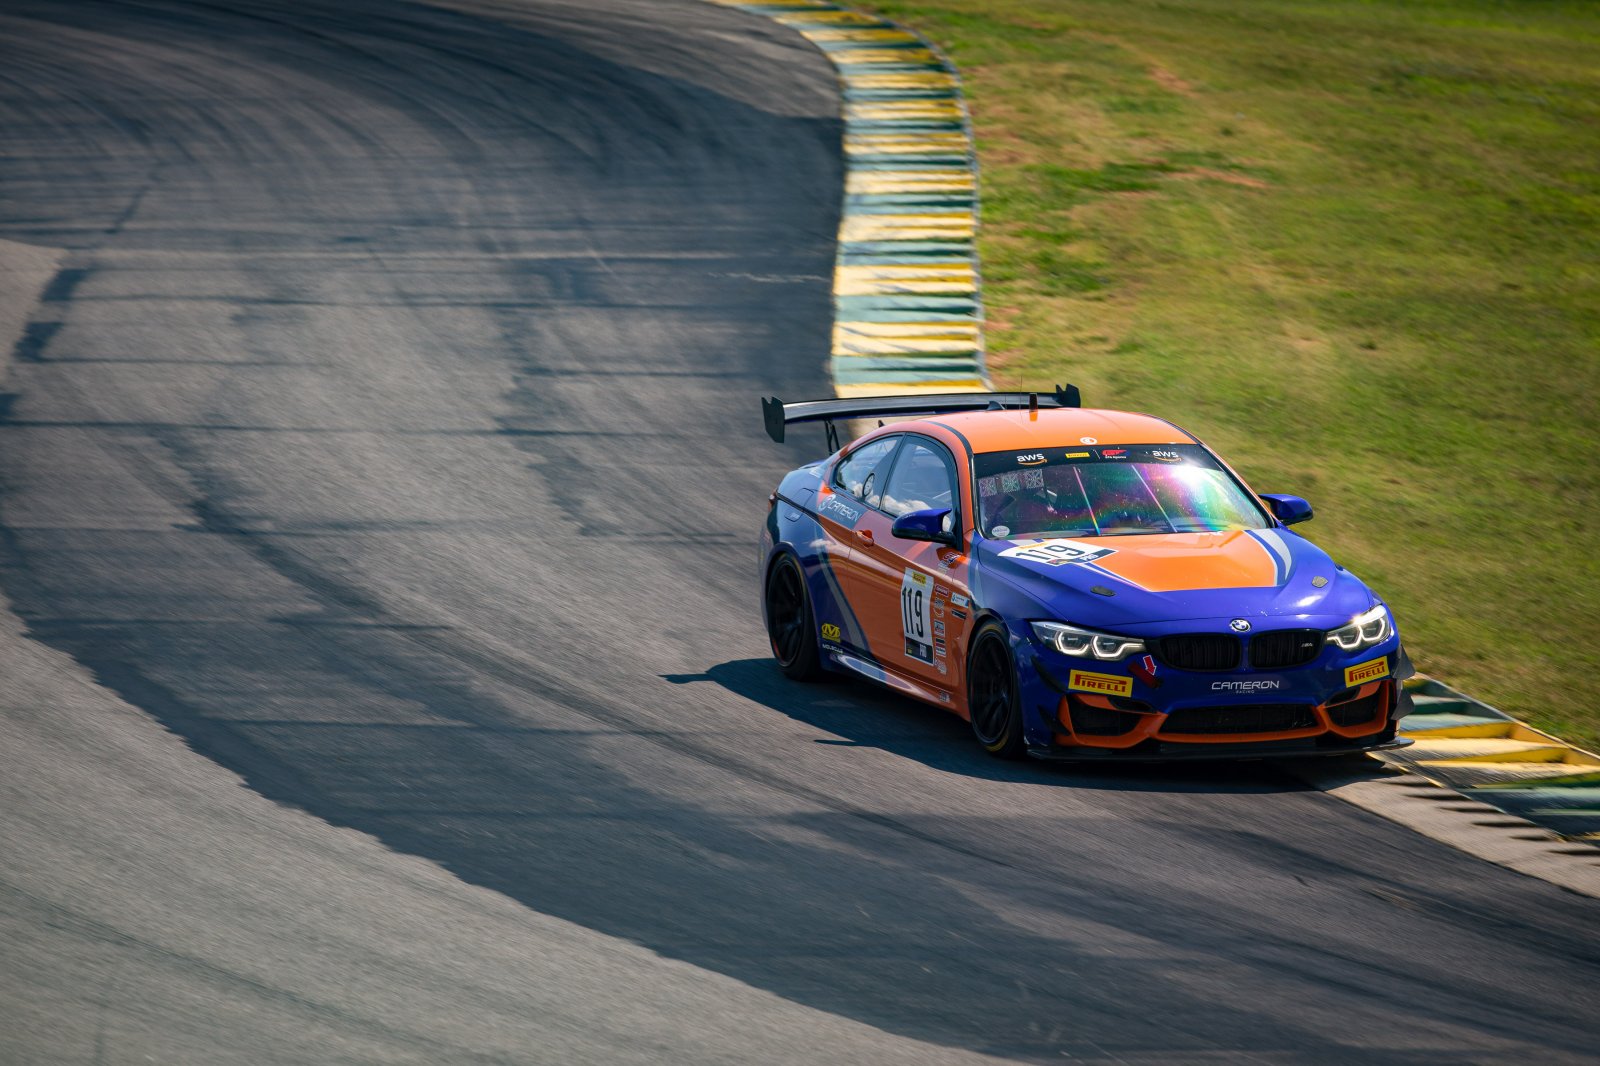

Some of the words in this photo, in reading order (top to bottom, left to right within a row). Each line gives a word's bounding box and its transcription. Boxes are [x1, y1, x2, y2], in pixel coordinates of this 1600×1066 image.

[1016, 453, 1045, 462] aws
[1152, 450, 1178, 458] aws
[1015, 544, 1086, 561] 119
[902, 586, 924, 638] 119
[1348, 661, 1386, 682] PIRELLI
[1074, 674, 1128, 693] PIRELLI
[1211, 680, 1280, 690] CAMERON
